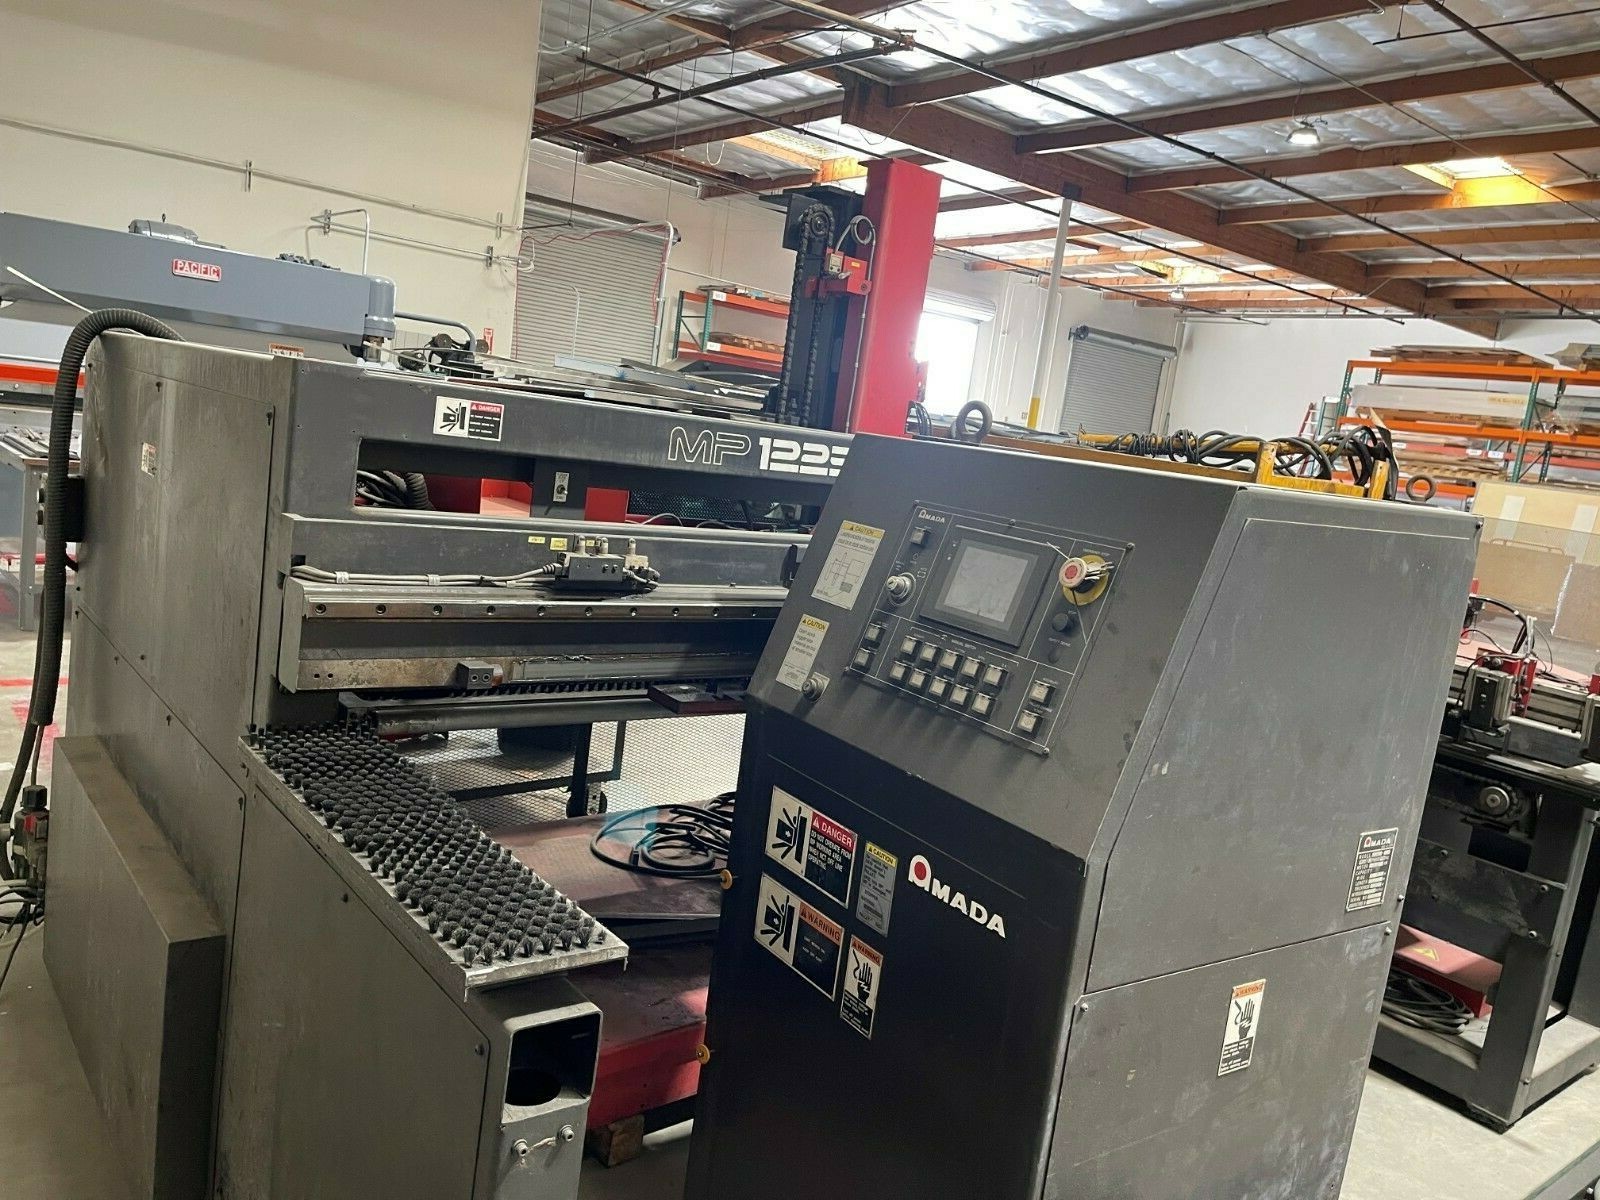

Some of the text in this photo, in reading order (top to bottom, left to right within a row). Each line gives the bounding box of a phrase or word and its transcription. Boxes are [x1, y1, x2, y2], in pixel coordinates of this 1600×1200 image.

[177, 260, 219, 277] PACIFIC
[478, 404, 501, 413] DANGER
[667, 426, 752, 466] MP
[806, 619, 826, 631] CAUTION
[821, 822, 852, 848] DANGER
[873, 848, 894, 864] CAUTION
[908, 854, 1006, 939] AMADA
[808, 911, 841, 941] WARNING
[857, 943, 880, 964] WARNING
